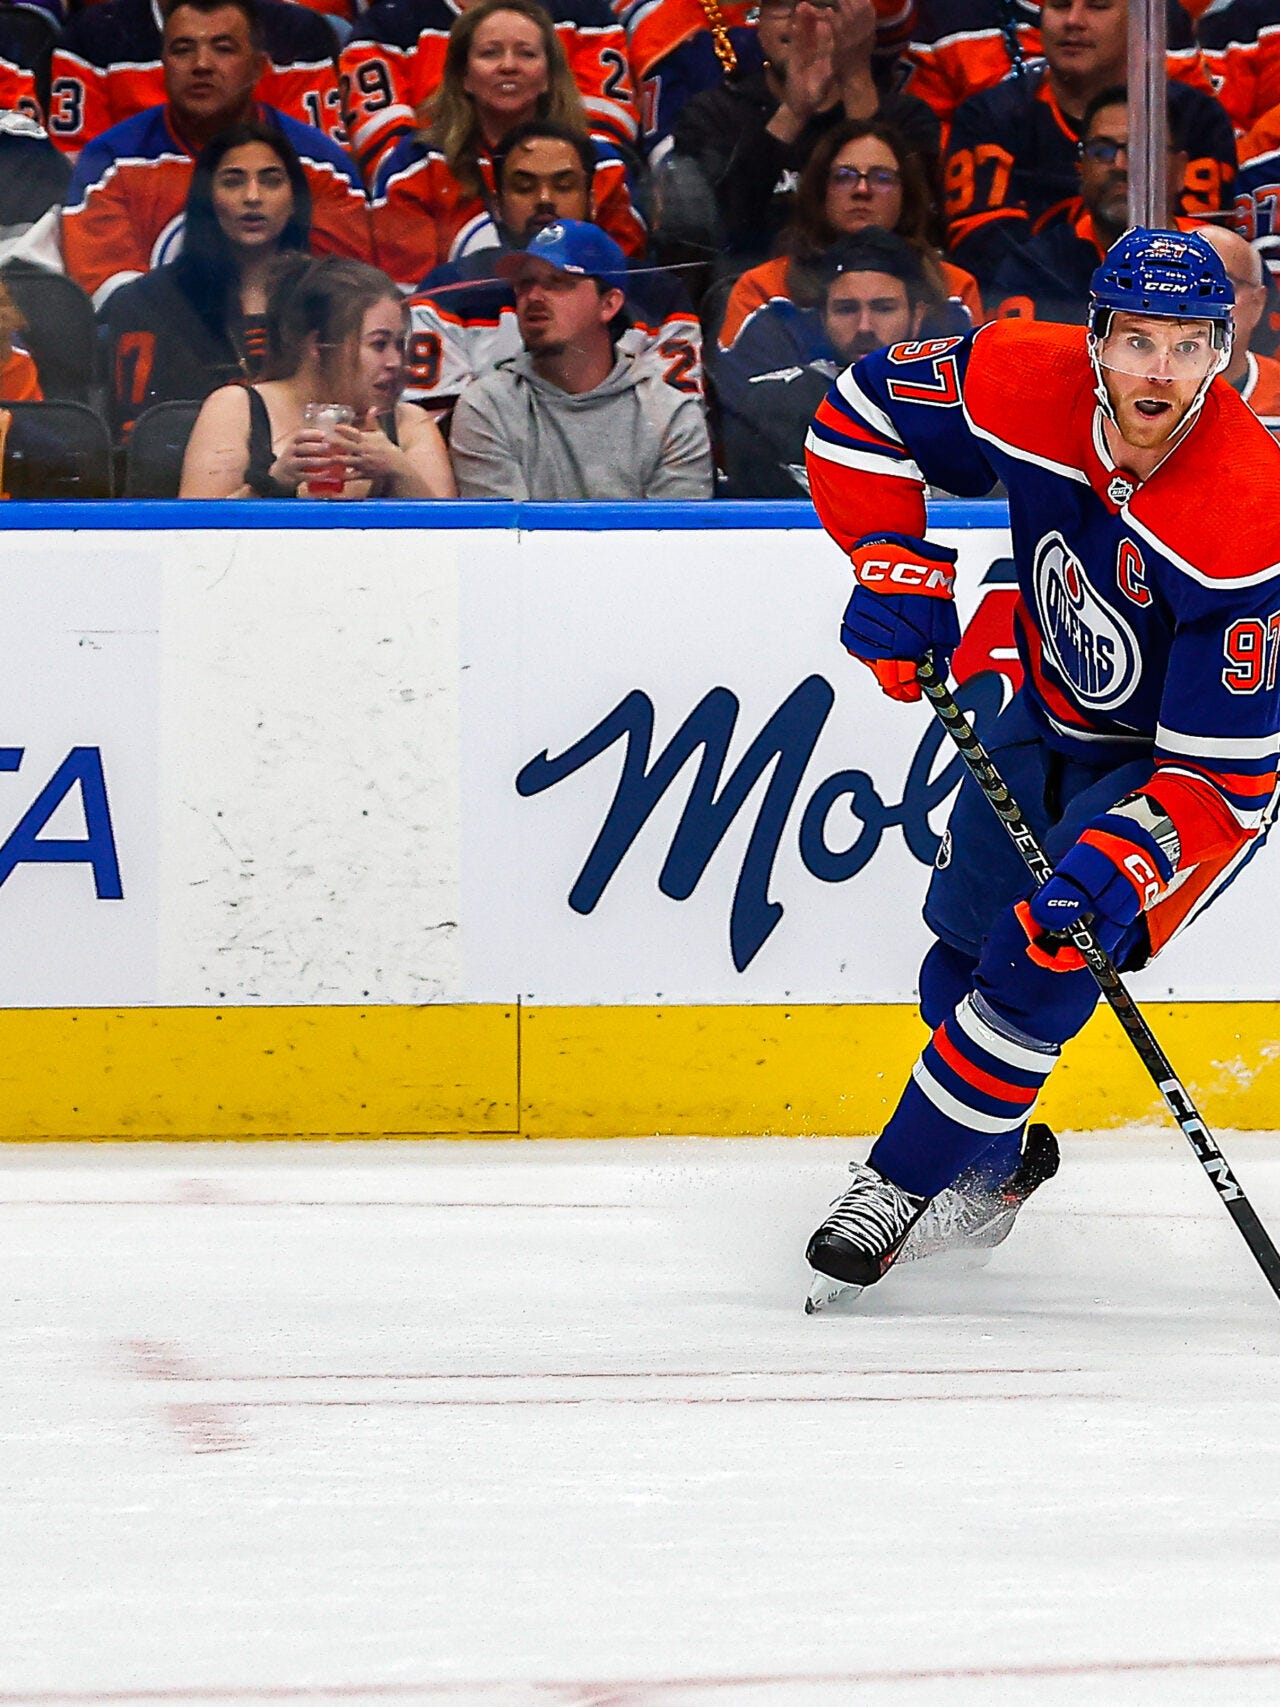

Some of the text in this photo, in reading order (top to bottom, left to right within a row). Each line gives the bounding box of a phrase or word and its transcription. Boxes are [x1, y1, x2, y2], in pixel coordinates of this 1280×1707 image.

[49, 76, 85, 136] 3
[944, 143, 1015, 214] 97
[1144, 282, 1188, 293] CCM
[887, 336, 964, 408] 97
[861, 560, 953, 595] CCM
[1117, 537, 1153, 608] C
[1046, 567, 1115, 694] OILERS
[516, 672, 1004, 973] Mol
[1047, 899, 1079, 908] CCM
[1123, 853, 1160, 904] CC
[1160, 1078, 1246, 1202] CCM
